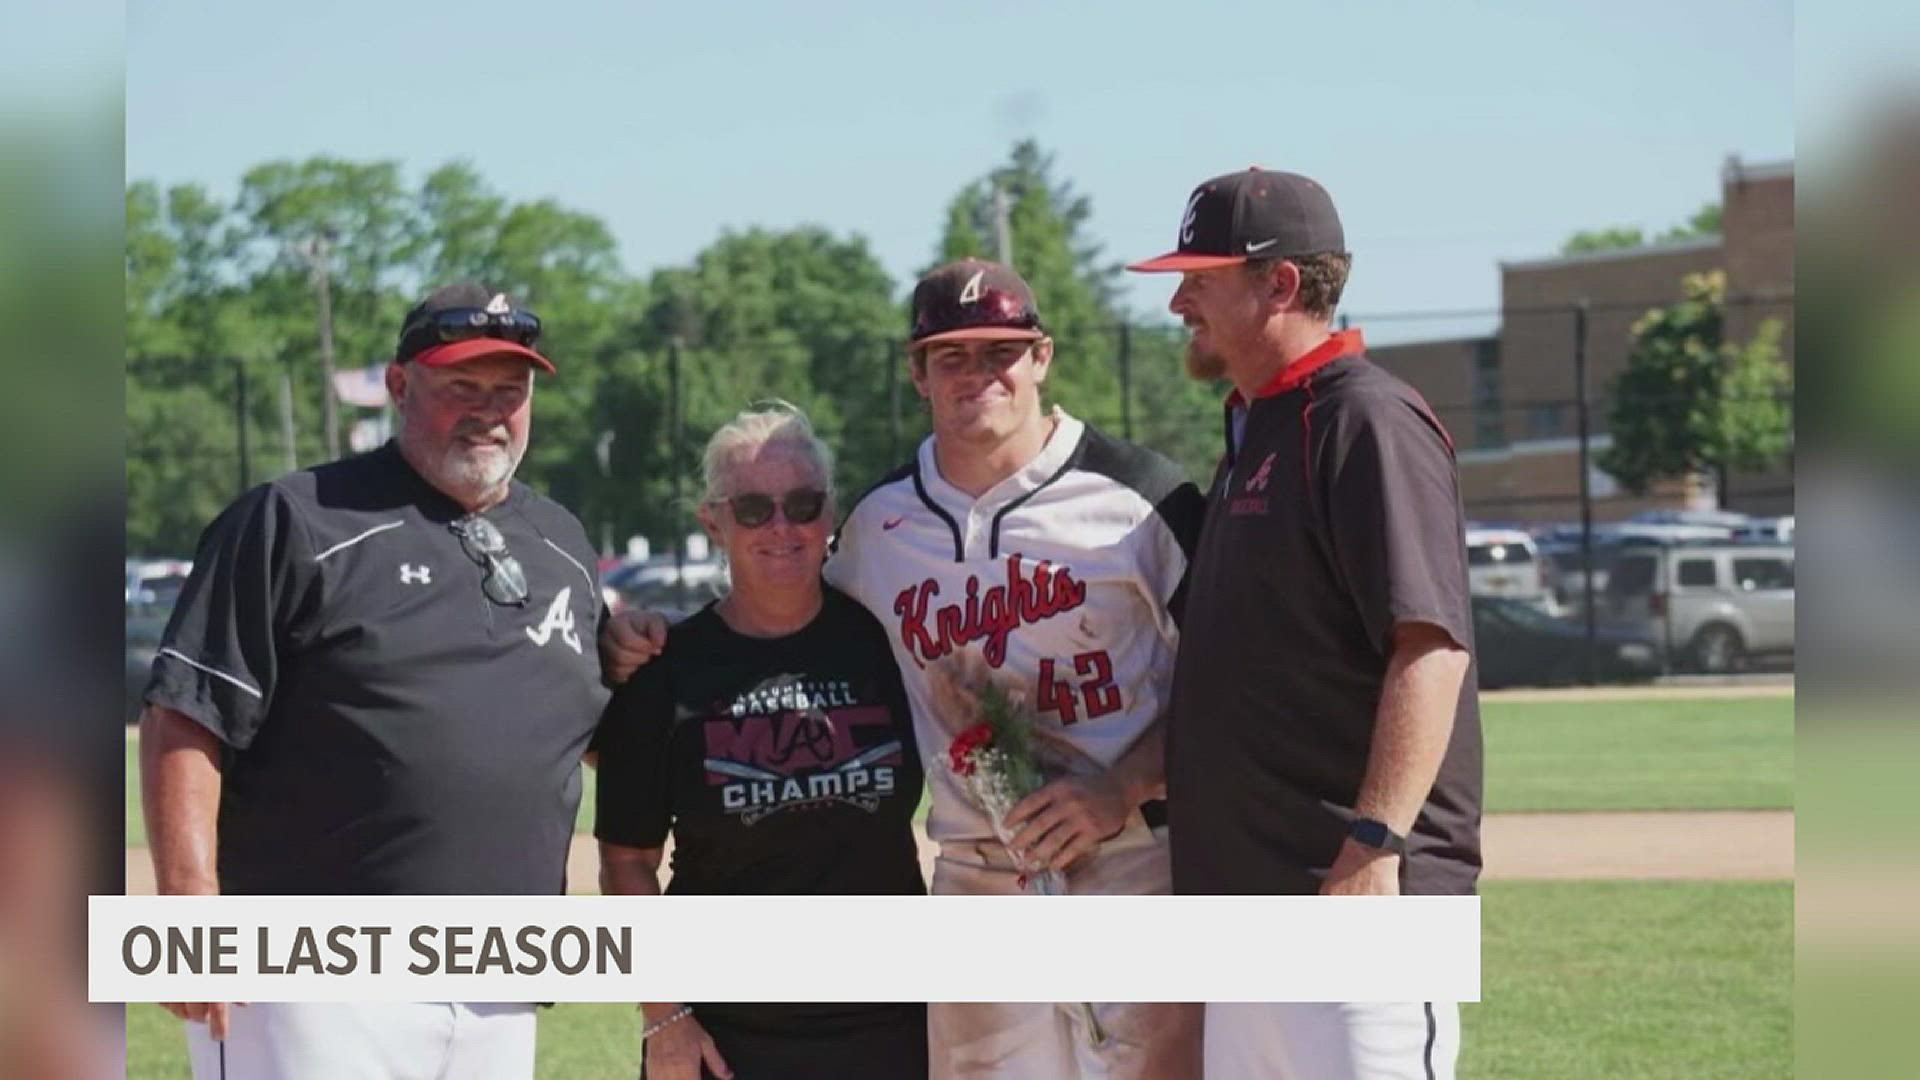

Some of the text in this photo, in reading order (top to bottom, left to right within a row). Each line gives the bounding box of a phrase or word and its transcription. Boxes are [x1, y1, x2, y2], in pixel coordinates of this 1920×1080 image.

[894, 553, 1086, 669] Knights
[1037, 650, 1122, 725] 42
[723, 767, 896, 809] CHAMPS
